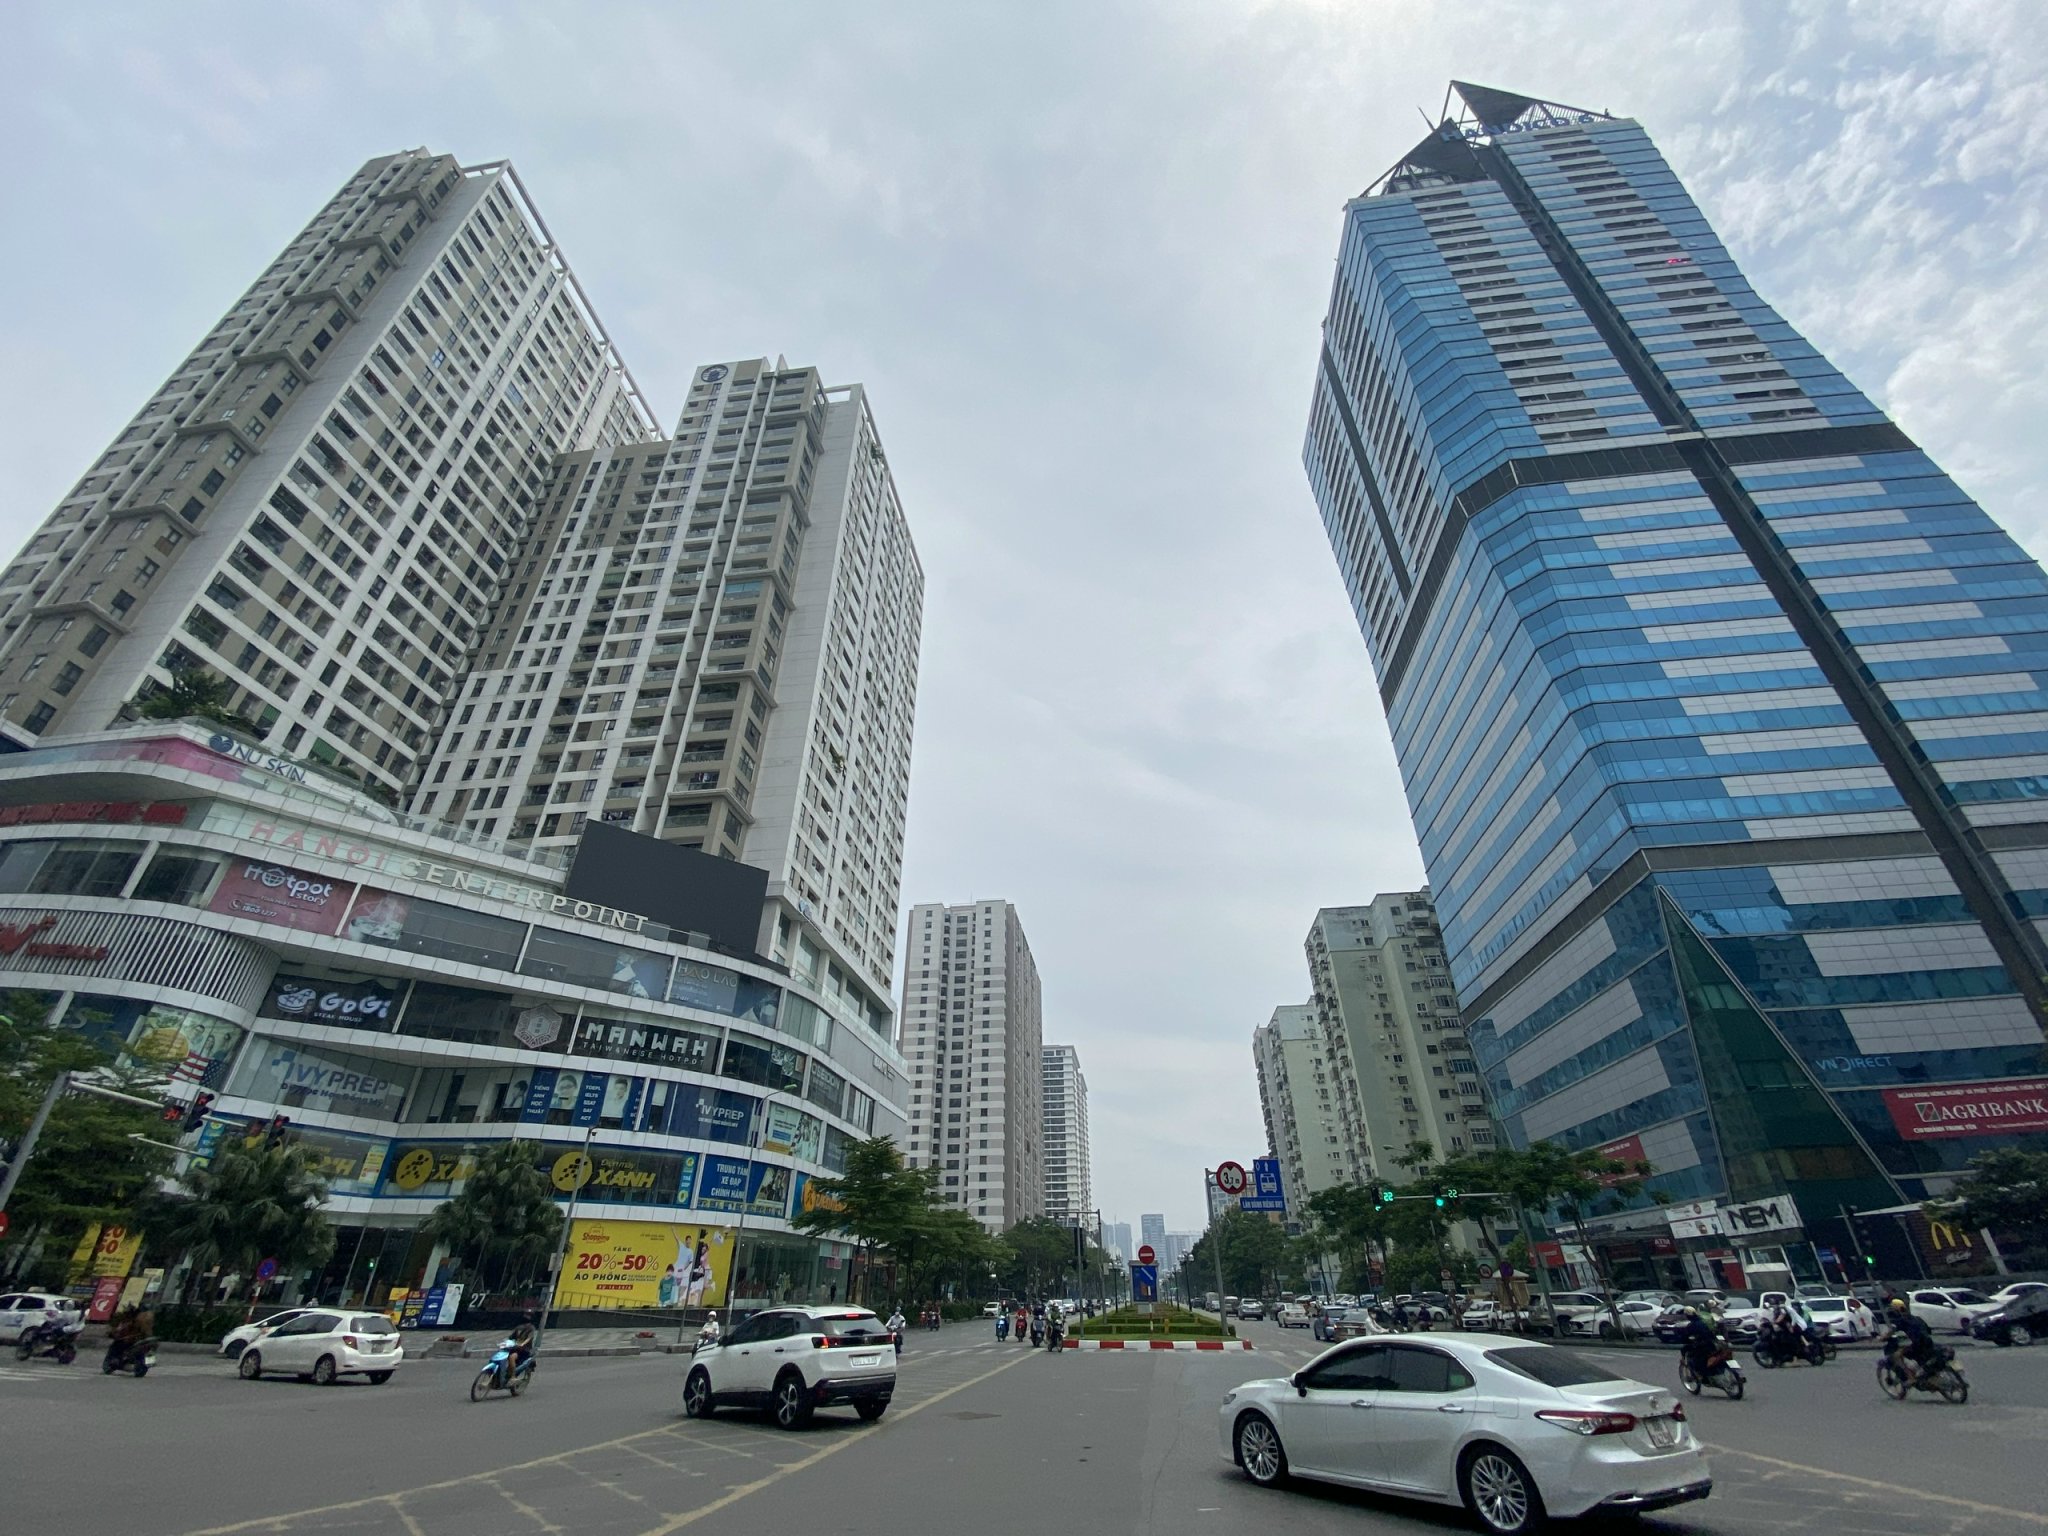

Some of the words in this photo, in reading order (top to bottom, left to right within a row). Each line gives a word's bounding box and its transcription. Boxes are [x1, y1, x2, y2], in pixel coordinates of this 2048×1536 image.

[233, 744, 262, 764] NU
[250, 820, 388, 870] HANOI
[401, 859, 648, 932] CENTERPOINT
[295, 893, 326, 906] story
[586, 1022, 708, 1057] MANWAH
[582, 1042, 653, 1058] TAIWANESE
[661, 1051, 705, 1065] HOTPOT
[1815, 1056, 1891, 1072] VNDIRECT
[701, 1105, 744, 1121] IVYPREP
[1941, 1098, 2048, 1120] AGRIBANK
[717, 1164, 736, 1174] TRUNG
[592, 1169, 656, 1188] XANH
[721, 1176, 729, 1185] XE
[1383, 1191, 1394, 1202] 22
[1448, 1189, 1458, 1198] 22
[1727, 1203, 1783, 1231] NEM
[593, 1272, 627, 1281] PHÔNG
[469, 1293, 487, 1308] 27
